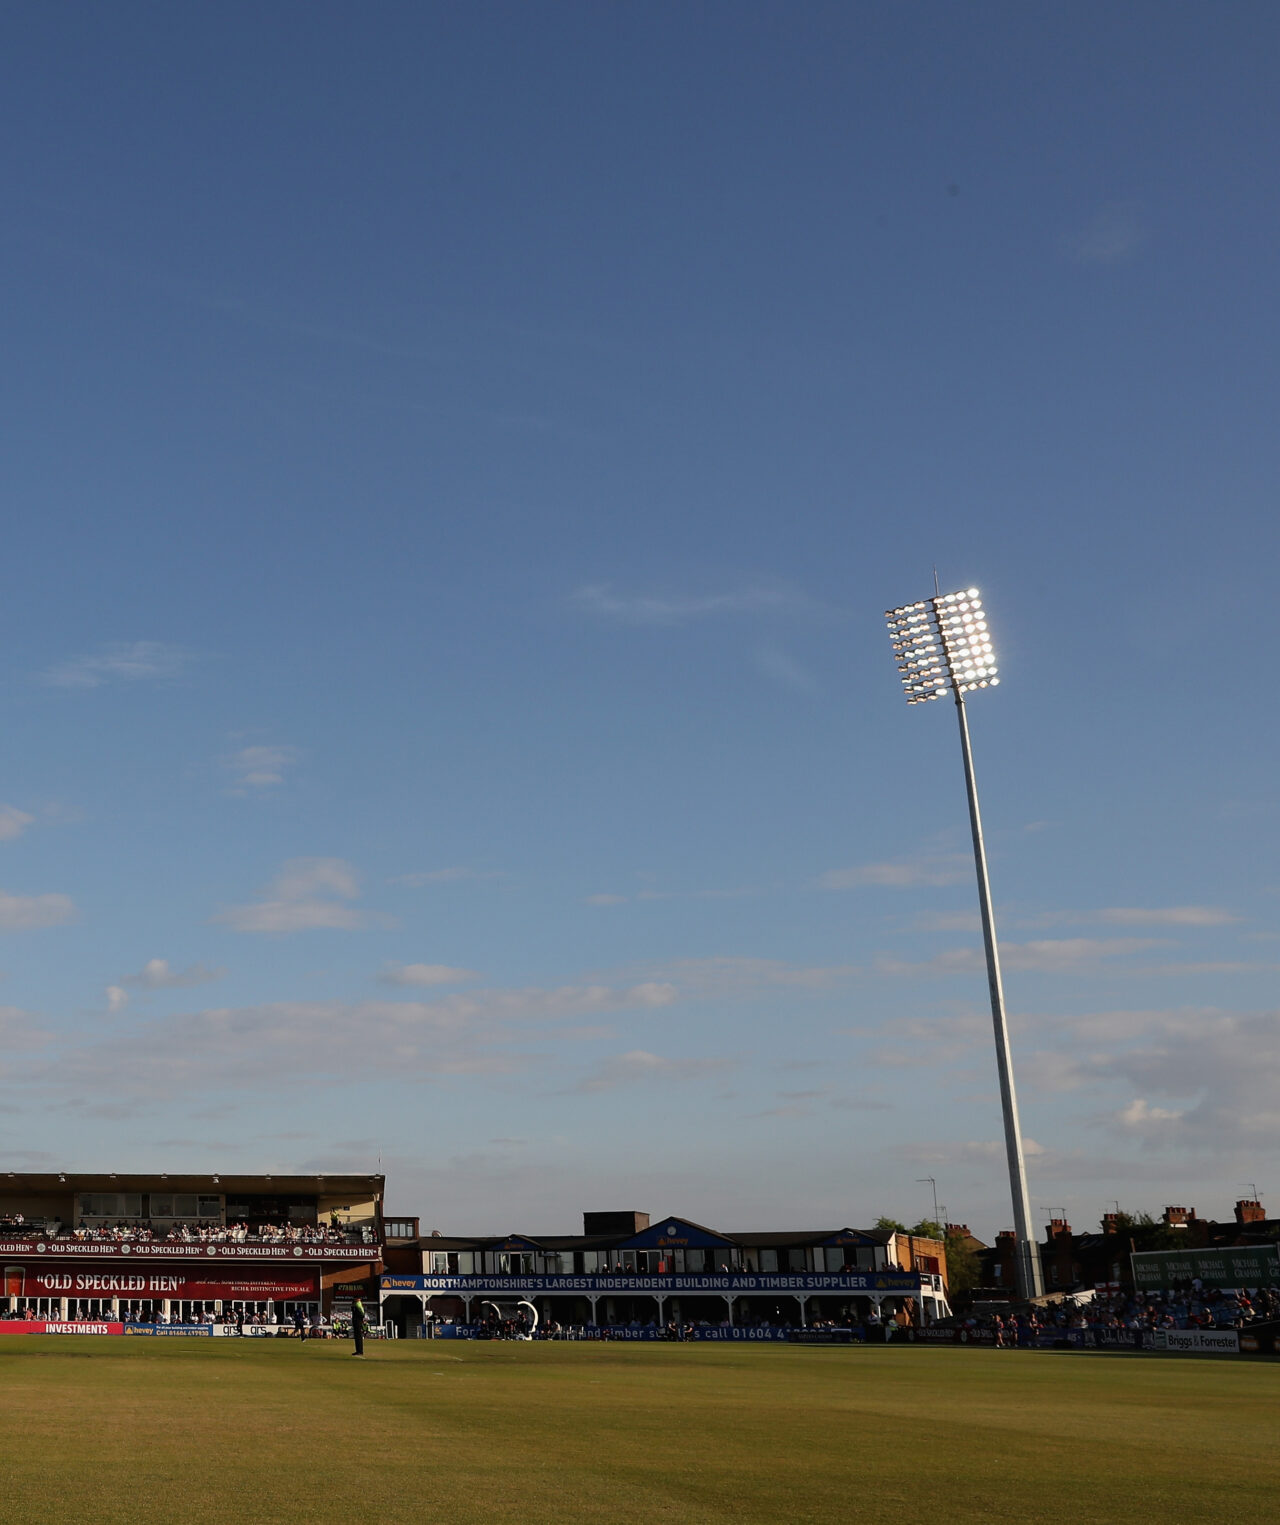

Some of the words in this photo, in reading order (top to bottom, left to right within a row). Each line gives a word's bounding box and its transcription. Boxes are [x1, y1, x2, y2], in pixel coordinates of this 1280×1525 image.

[76, 1274, 145, 1291] SPECKLED
[392, 1278, 416, 1288] hevey
[424, 1278, 543, 1288] NORTHAMPTONSHIRE'S
[546, 1278, 593, 1288] LARGEST
[596, 1278, 672, 1288] INDEPENDENT
[675, 1278, 729, 1288] BUILDING
[732, 1278, 756, 1288] AND
[759, 1277, 804, 1288] TIMBER
[807, 1277, 867, 1288] SUPPLIER
[45, 1323, 108, 1334] INVESTMENTS
[134, 1327, 153, 1335] hevey
[456, 1326, 474, 1336] For
[611, 1328, 644, 1338] imber
[705, 1328, 727, 1338] call
[733, 1328, 772, 1338] 01604
[1168, 1335, 1192, 1348] Briggs
[1200, 1335, 1236, 1347] Forrester
